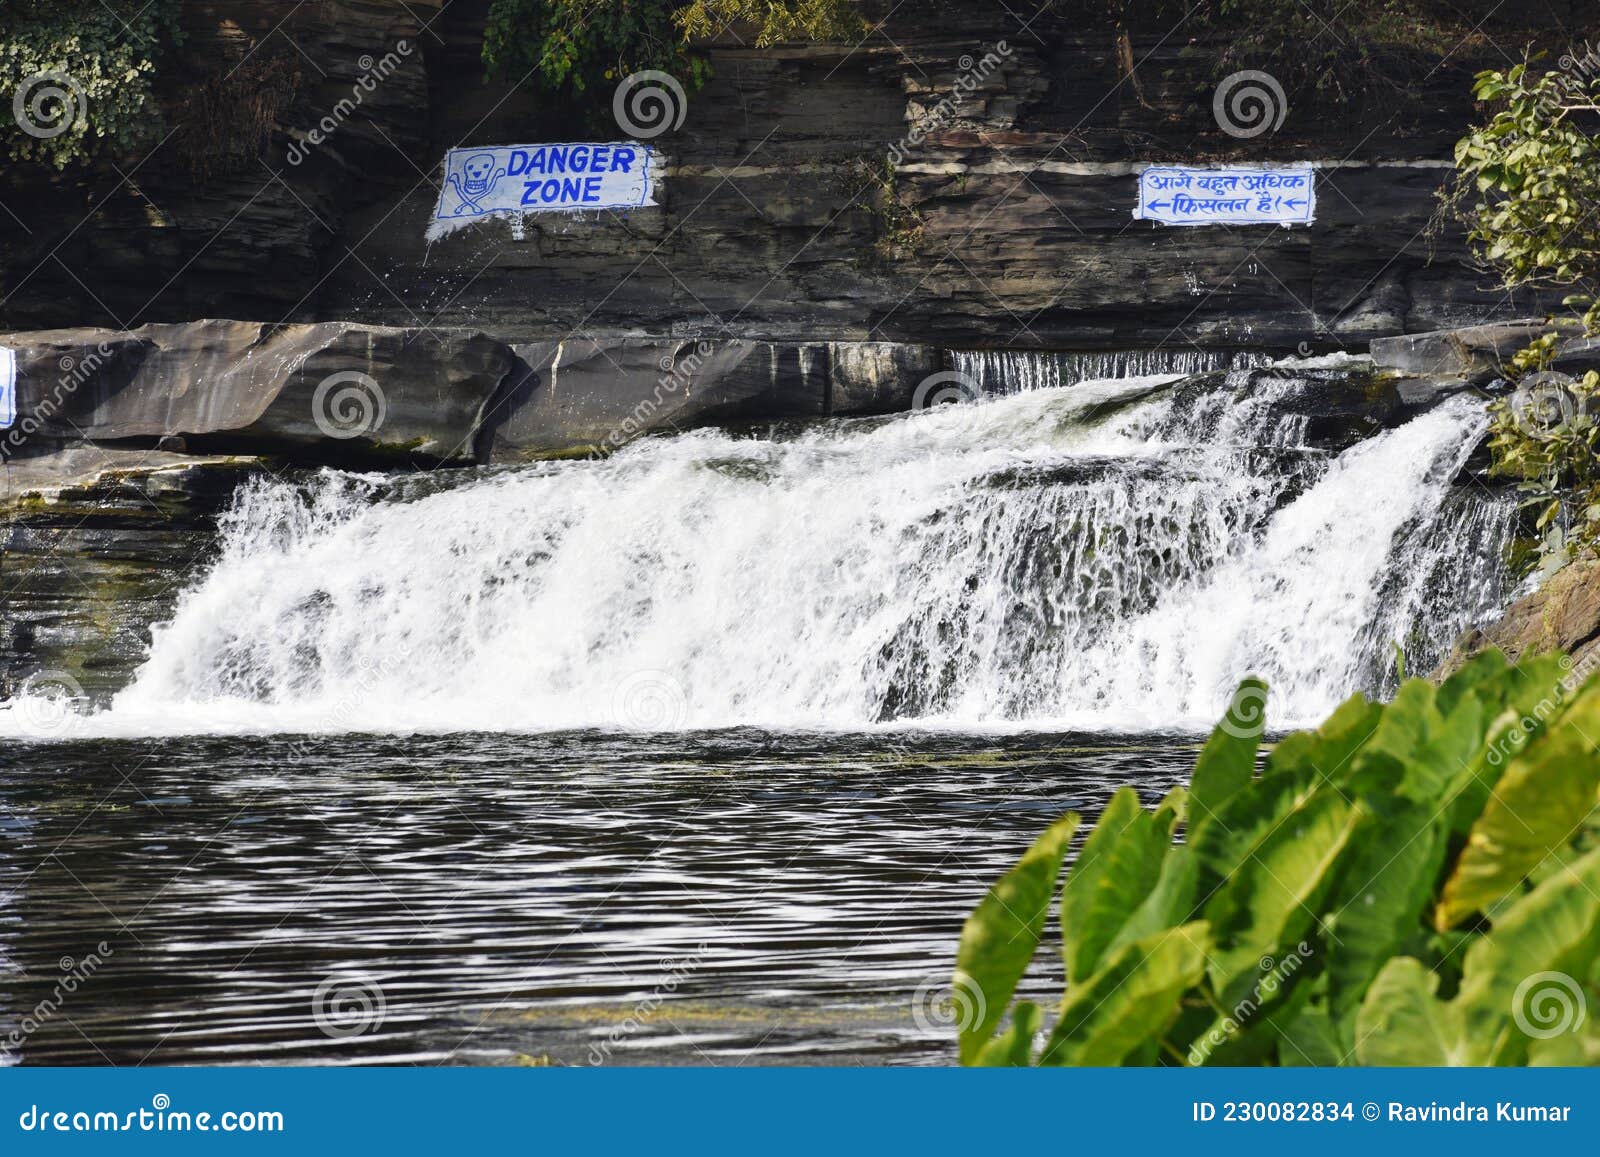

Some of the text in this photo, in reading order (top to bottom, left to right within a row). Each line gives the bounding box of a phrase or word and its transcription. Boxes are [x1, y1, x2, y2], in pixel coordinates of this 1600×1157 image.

[507, 146, 636, 176] DANGER
[521, 176, 603, 205] ZONE
[1147, 171, 1304, 196] आगे बहुत अधिक
[1171, 193, 1249, 215] फिसलन
